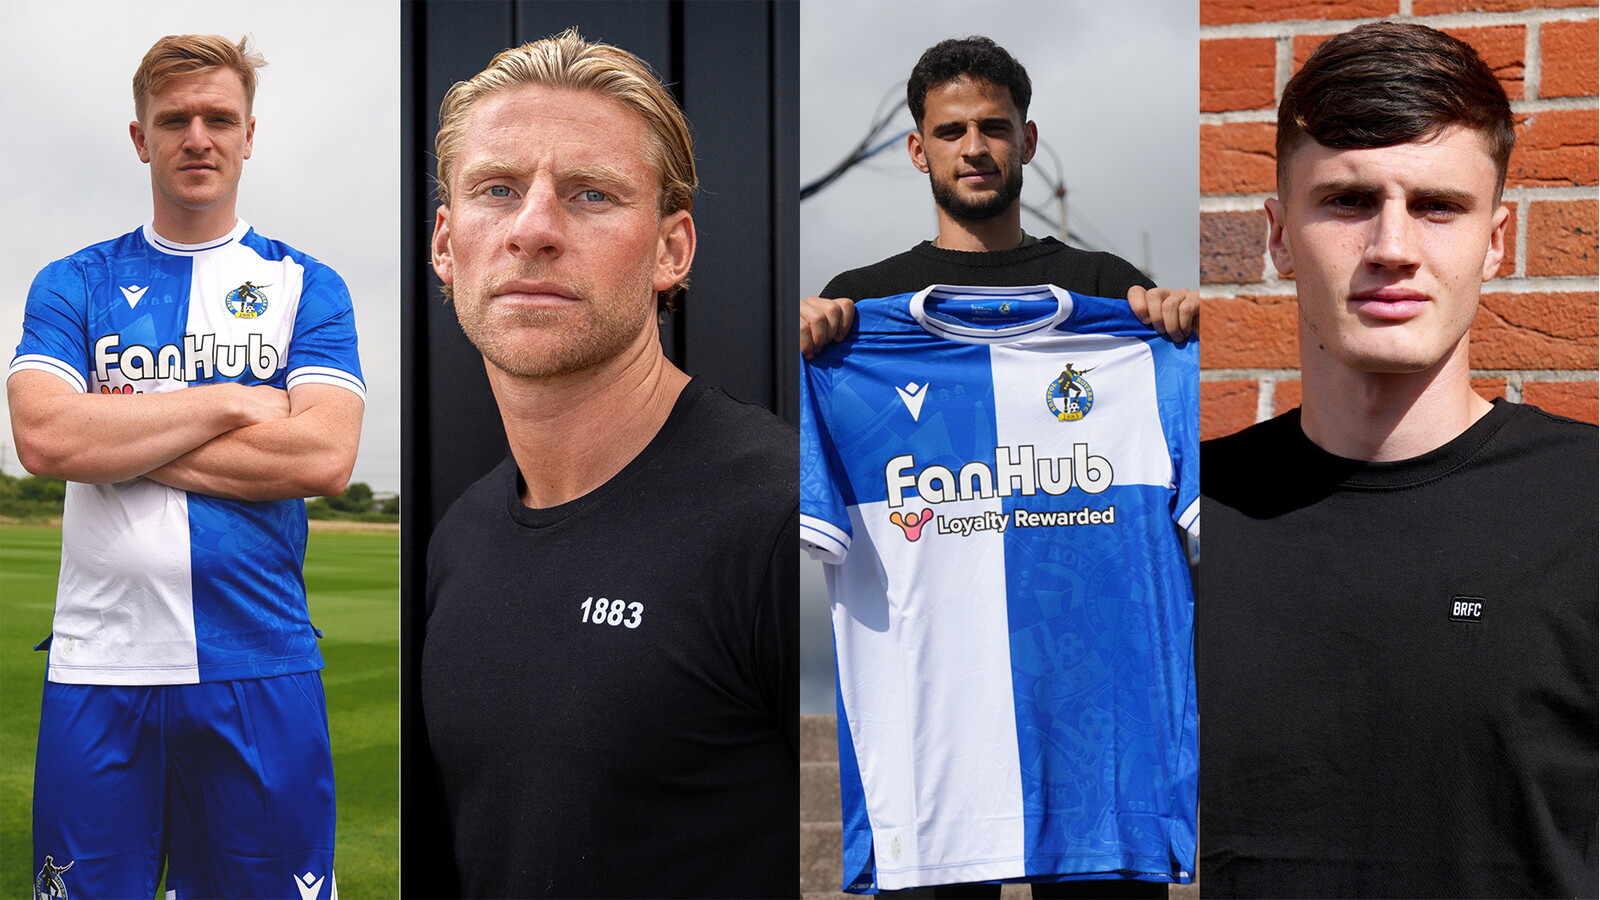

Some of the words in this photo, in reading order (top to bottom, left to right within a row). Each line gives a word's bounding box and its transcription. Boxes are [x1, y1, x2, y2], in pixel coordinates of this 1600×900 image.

[94, 333, 279, 382] FanHub
[1047, 383, 1057, 412] BRISTOL
[1076, 377, 1093, 402] ROVERS
[884, 443, 1114, 508] FanHub
[937, 511, 1010, 536] Loyalty
[1014, 505, 1115, 528] Rewarded
[581, 597, 644, 629] 1883
[1453, 601, 1482, 617] BRFC
